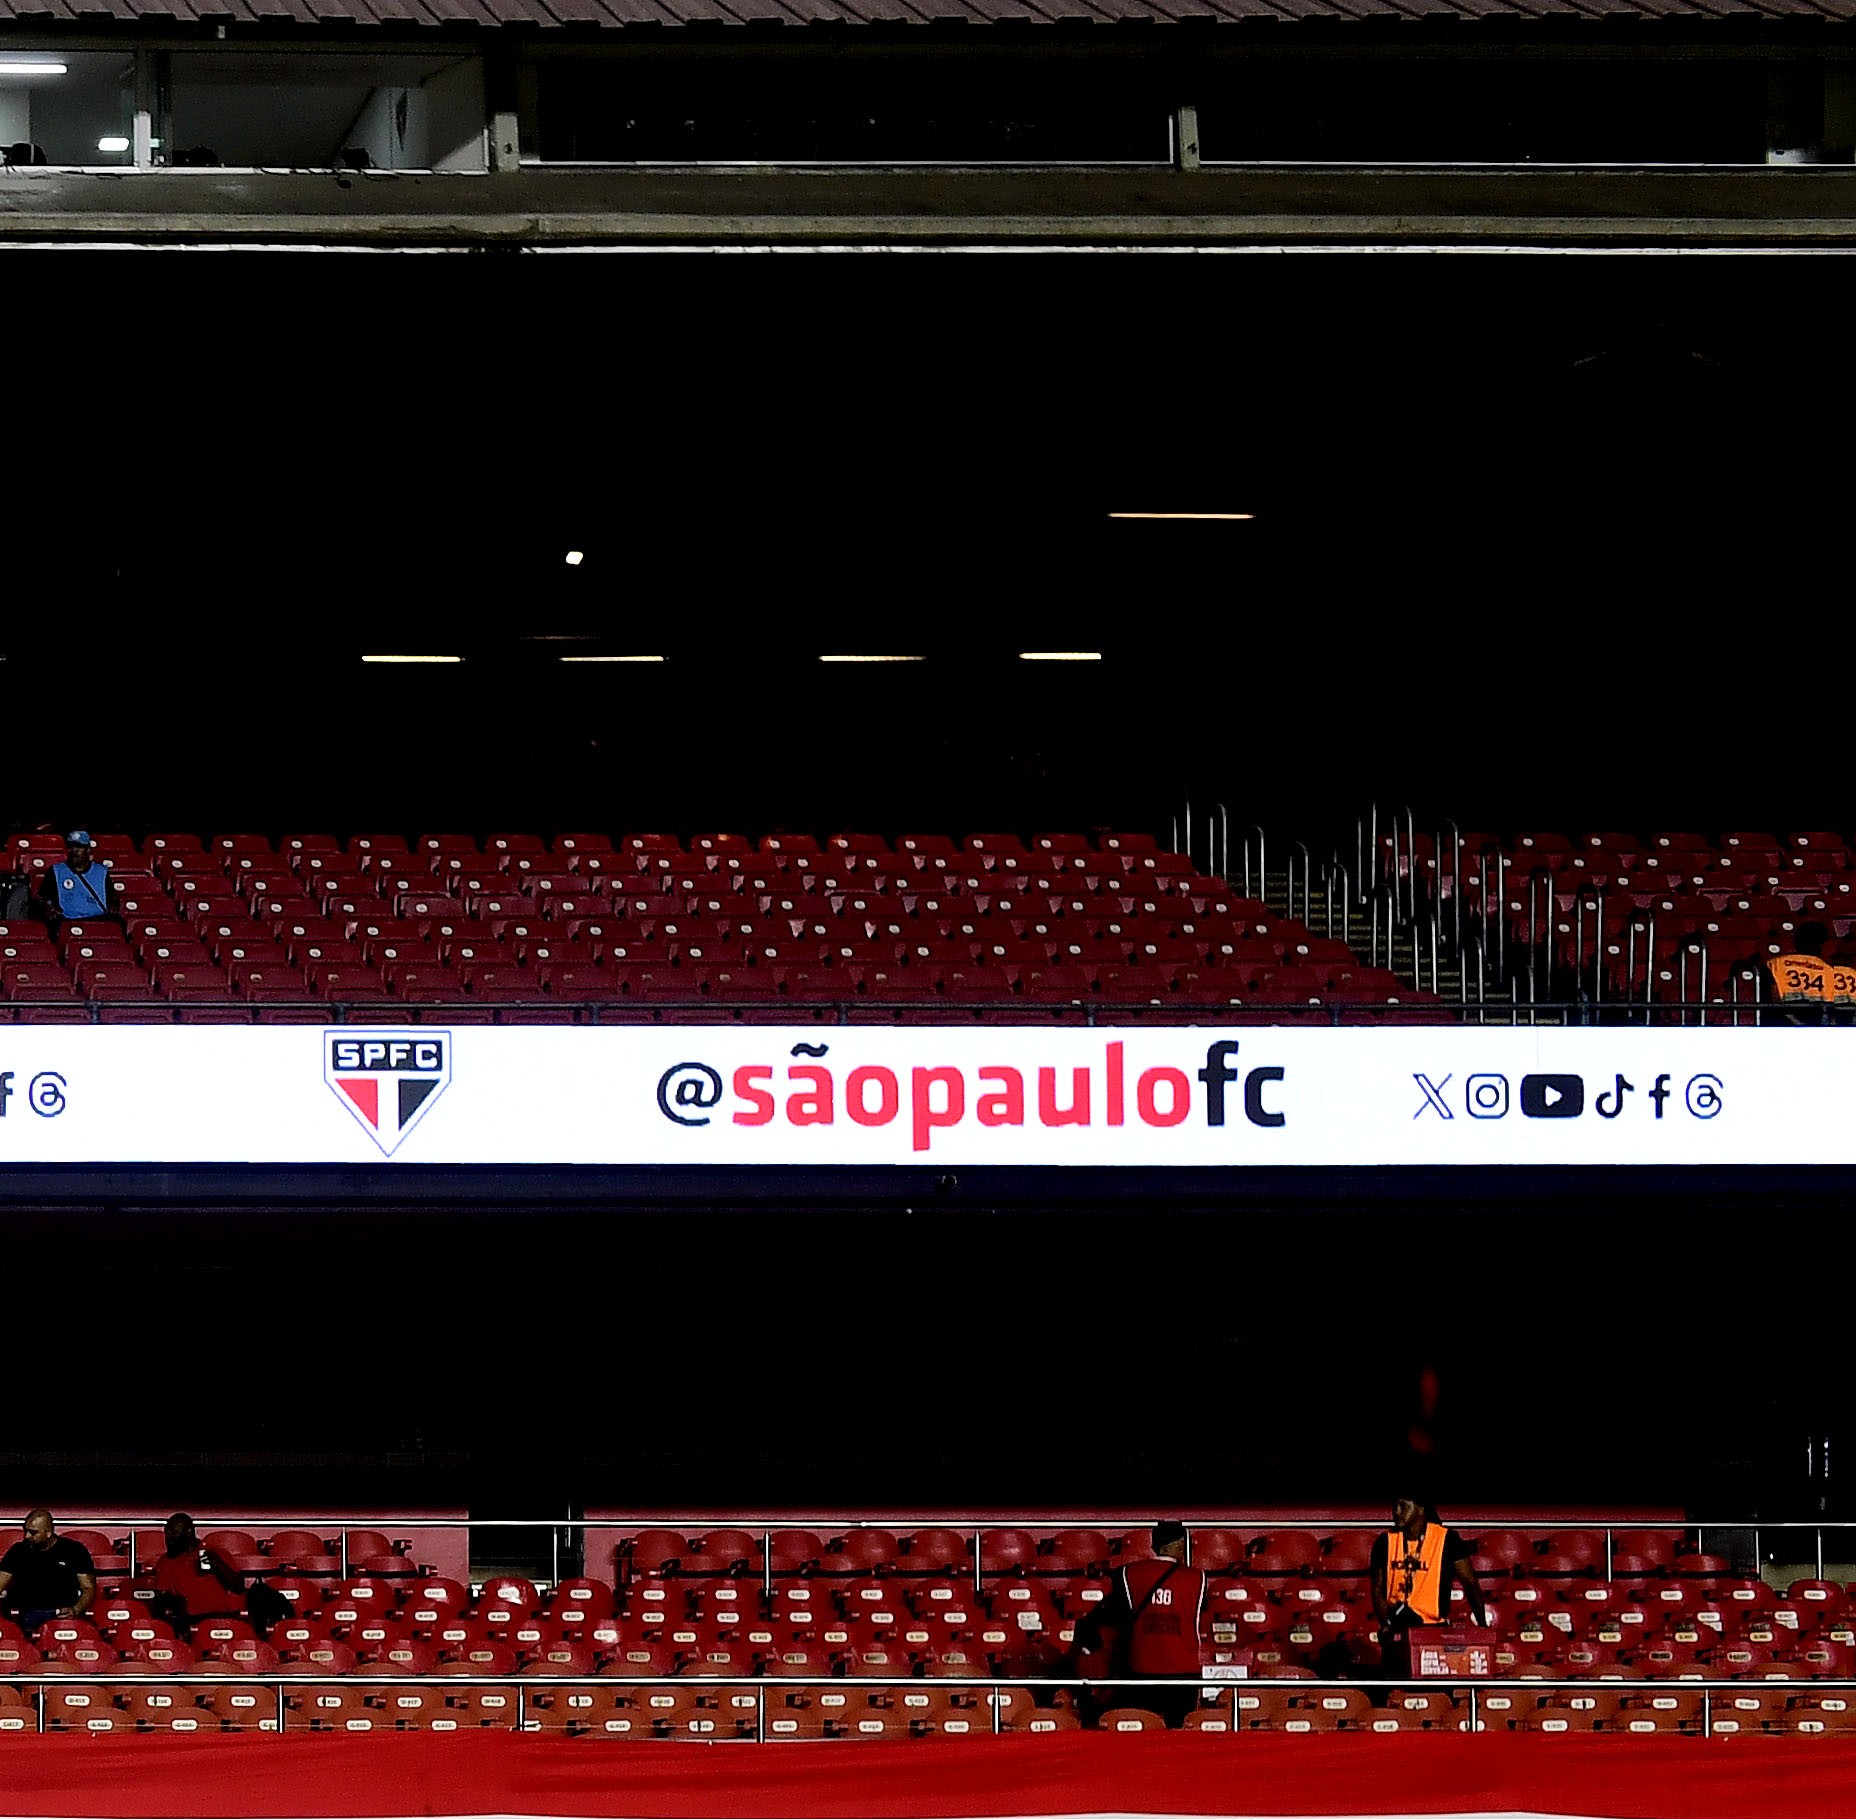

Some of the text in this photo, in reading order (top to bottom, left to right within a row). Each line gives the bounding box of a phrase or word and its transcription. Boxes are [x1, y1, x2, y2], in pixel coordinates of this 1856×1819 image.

[1786, 970, 1824, 991] 334
[337, 1042, 440, 1069] SPFC
[657, 1040, 1287, 1152] @sãopaulofc
